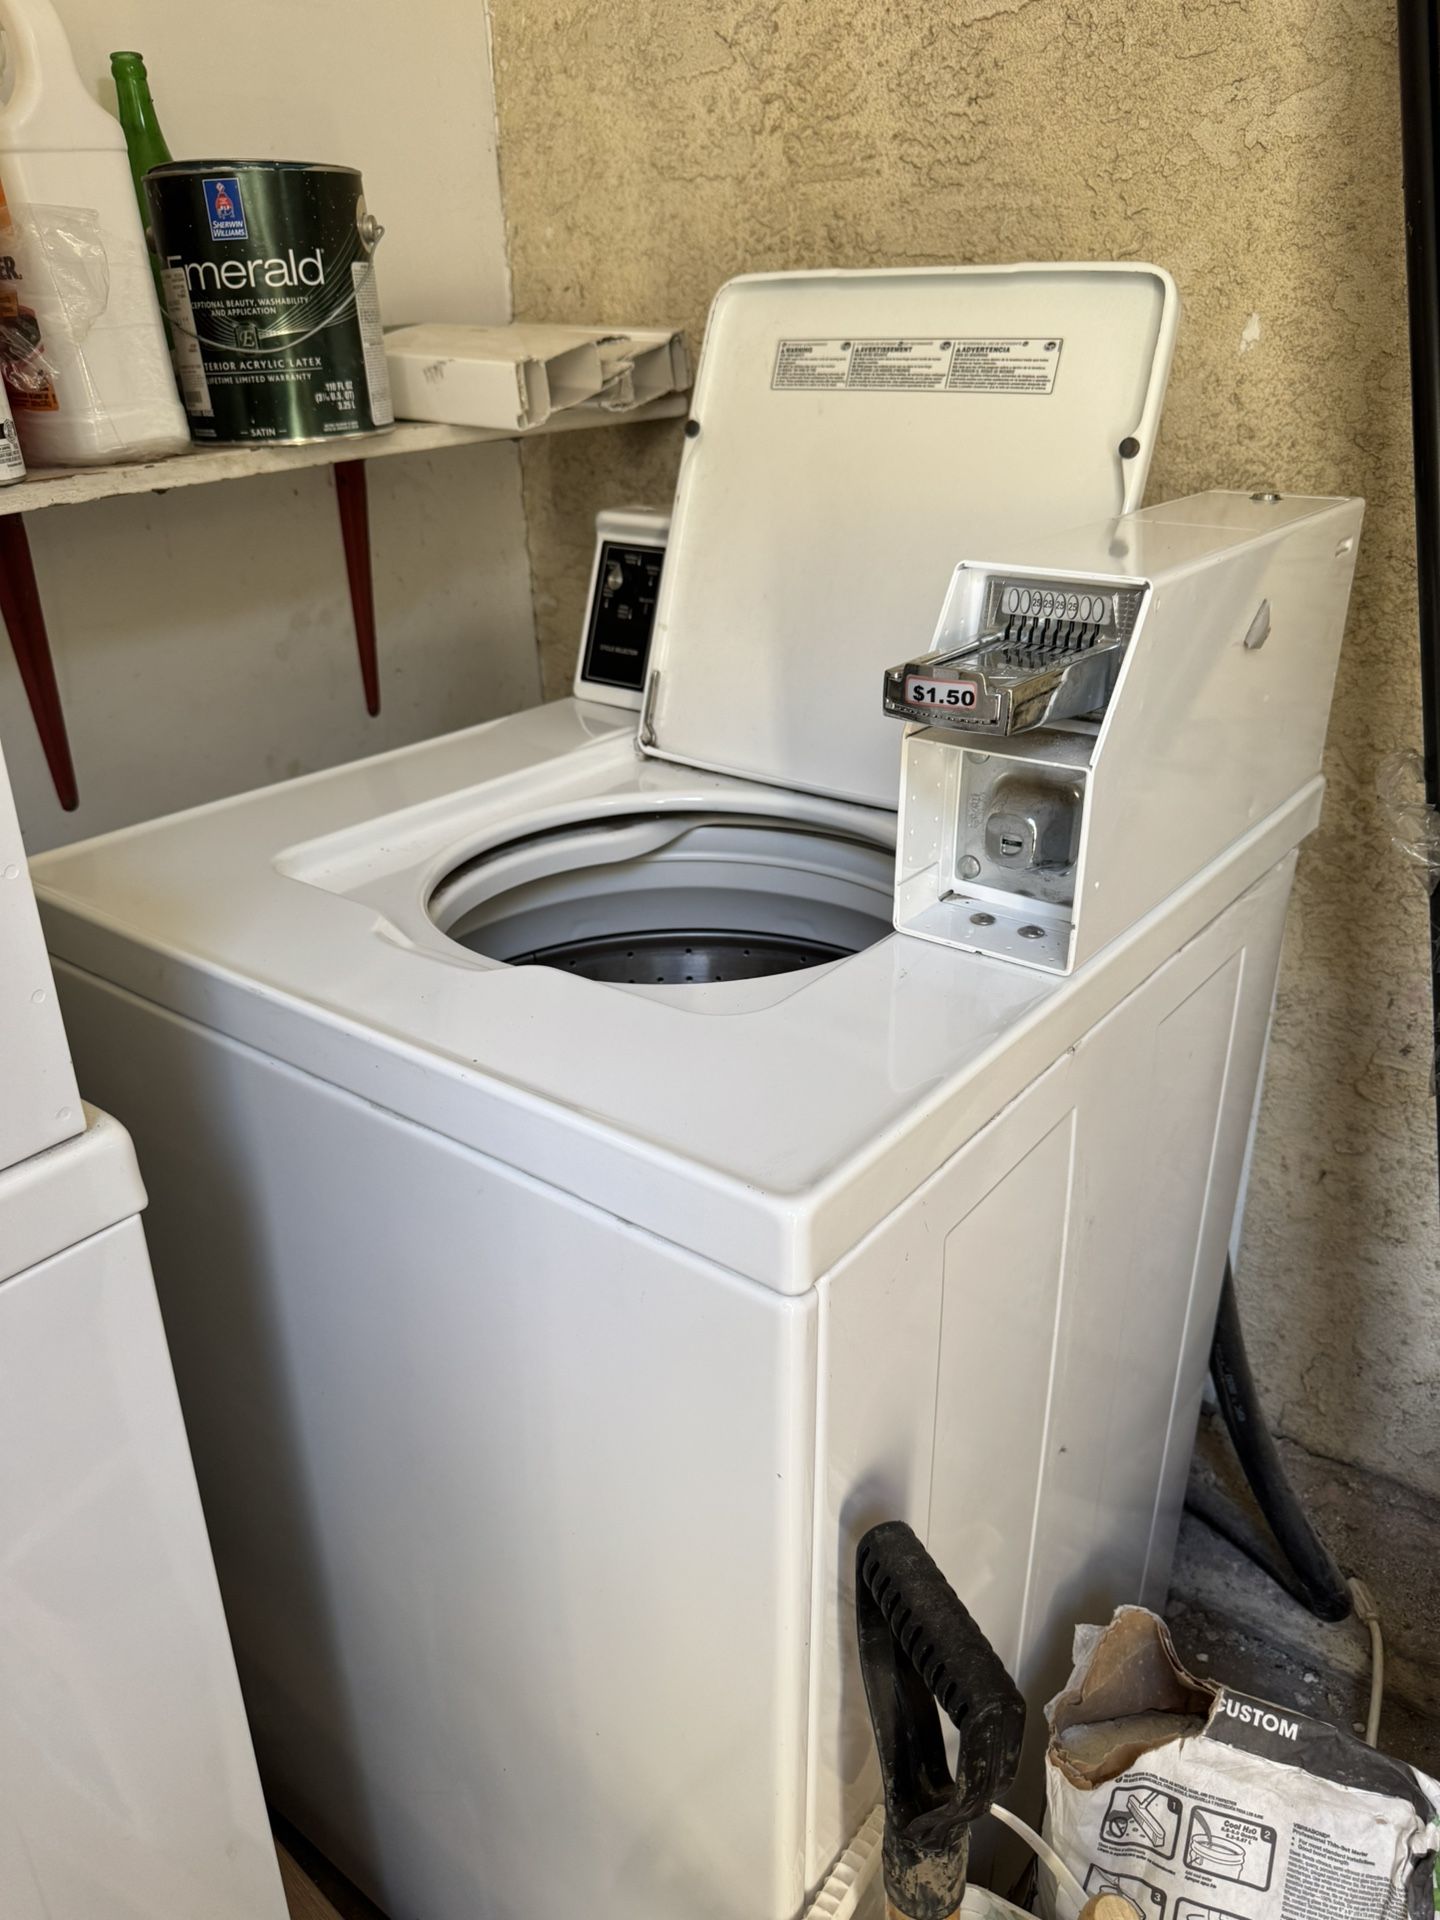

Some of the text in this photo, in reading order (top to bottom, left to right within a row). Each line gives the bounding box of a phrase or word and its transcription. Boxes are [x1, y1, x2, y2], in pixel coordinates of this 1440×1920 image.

[213, 229, 245, 237] WILLIAMS
[259, 296, 309, 305] WASHABILITY
[212, 306, 277, 317] AND APPLICATION
[240, 359, 285, 370] ACRYLIC
[289, 357, 322, 367] LATEX
[235, 375, 265, 384] LIMITED
[267, 373, 311, 383] WARRANTY
[251, 427, 276, 437] SATIN
[1032, 598, 1041, 607] 25
[1043, 600, 1053, 609] 25
[1055, 600, 1065, 610] 25
[1068, 602, 1077, 612] 25
[913, 685, 975, 706] $1.50
[1224, 1820, 1241, 1829] Cool
[1263, 1830, 1271, 1840] 2
[1291, 1829, 1326, 1843] Professional
[1297, 1844, 1312, 1852] Good
[1326, 1855, 1349, 1865] strength
[1322, 1847, 1345, 1858] standard
[1153, 1893, 1161, 1902] 3
